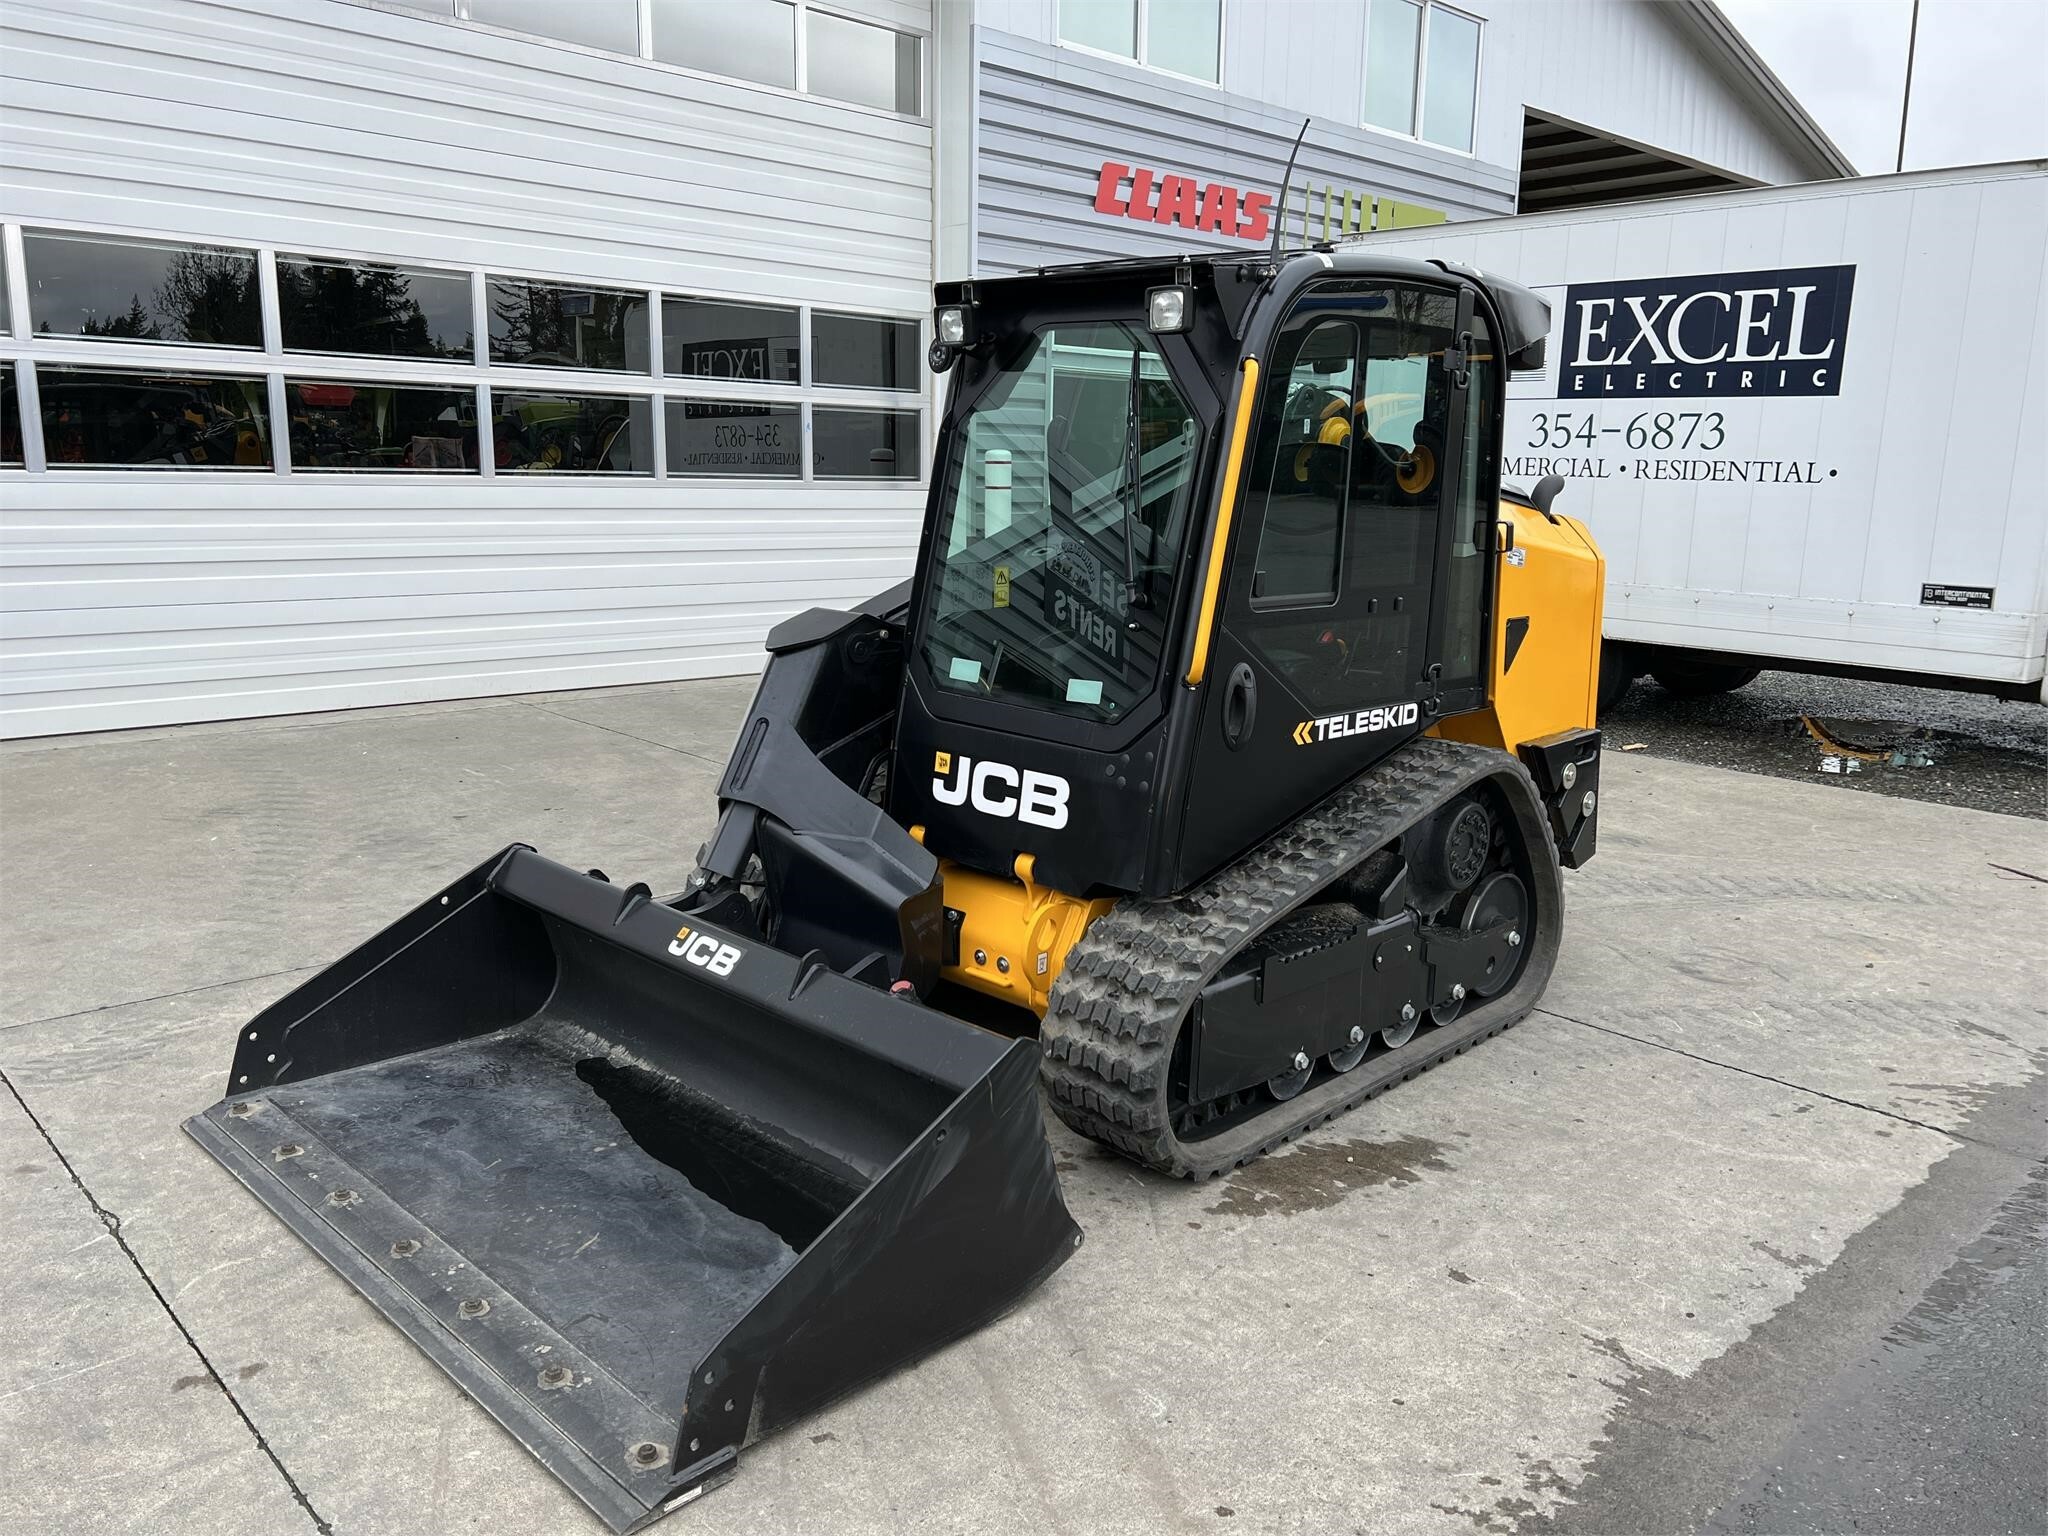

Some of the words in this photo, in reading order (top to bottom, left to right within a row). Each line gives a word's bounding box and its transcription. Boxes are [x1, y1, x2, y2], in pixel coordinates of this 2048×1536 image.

[1094, 162, 1272, 242] CLAAS
[1570, 286, 1836, 367] EXCEL
[1574, 367, 1829, 392] ELECTRIC
[1528, 411, 1726, 450] 354-6873
[1501, 457, 1611, 479] MERCIAL
[1634, 458, 1823, 485] RESIDENTIAL
[1315, 702, 1419, 743] TELESKID
[932, 754, 1070, 830] JCB
[667, 929, 742, 976] JCB
